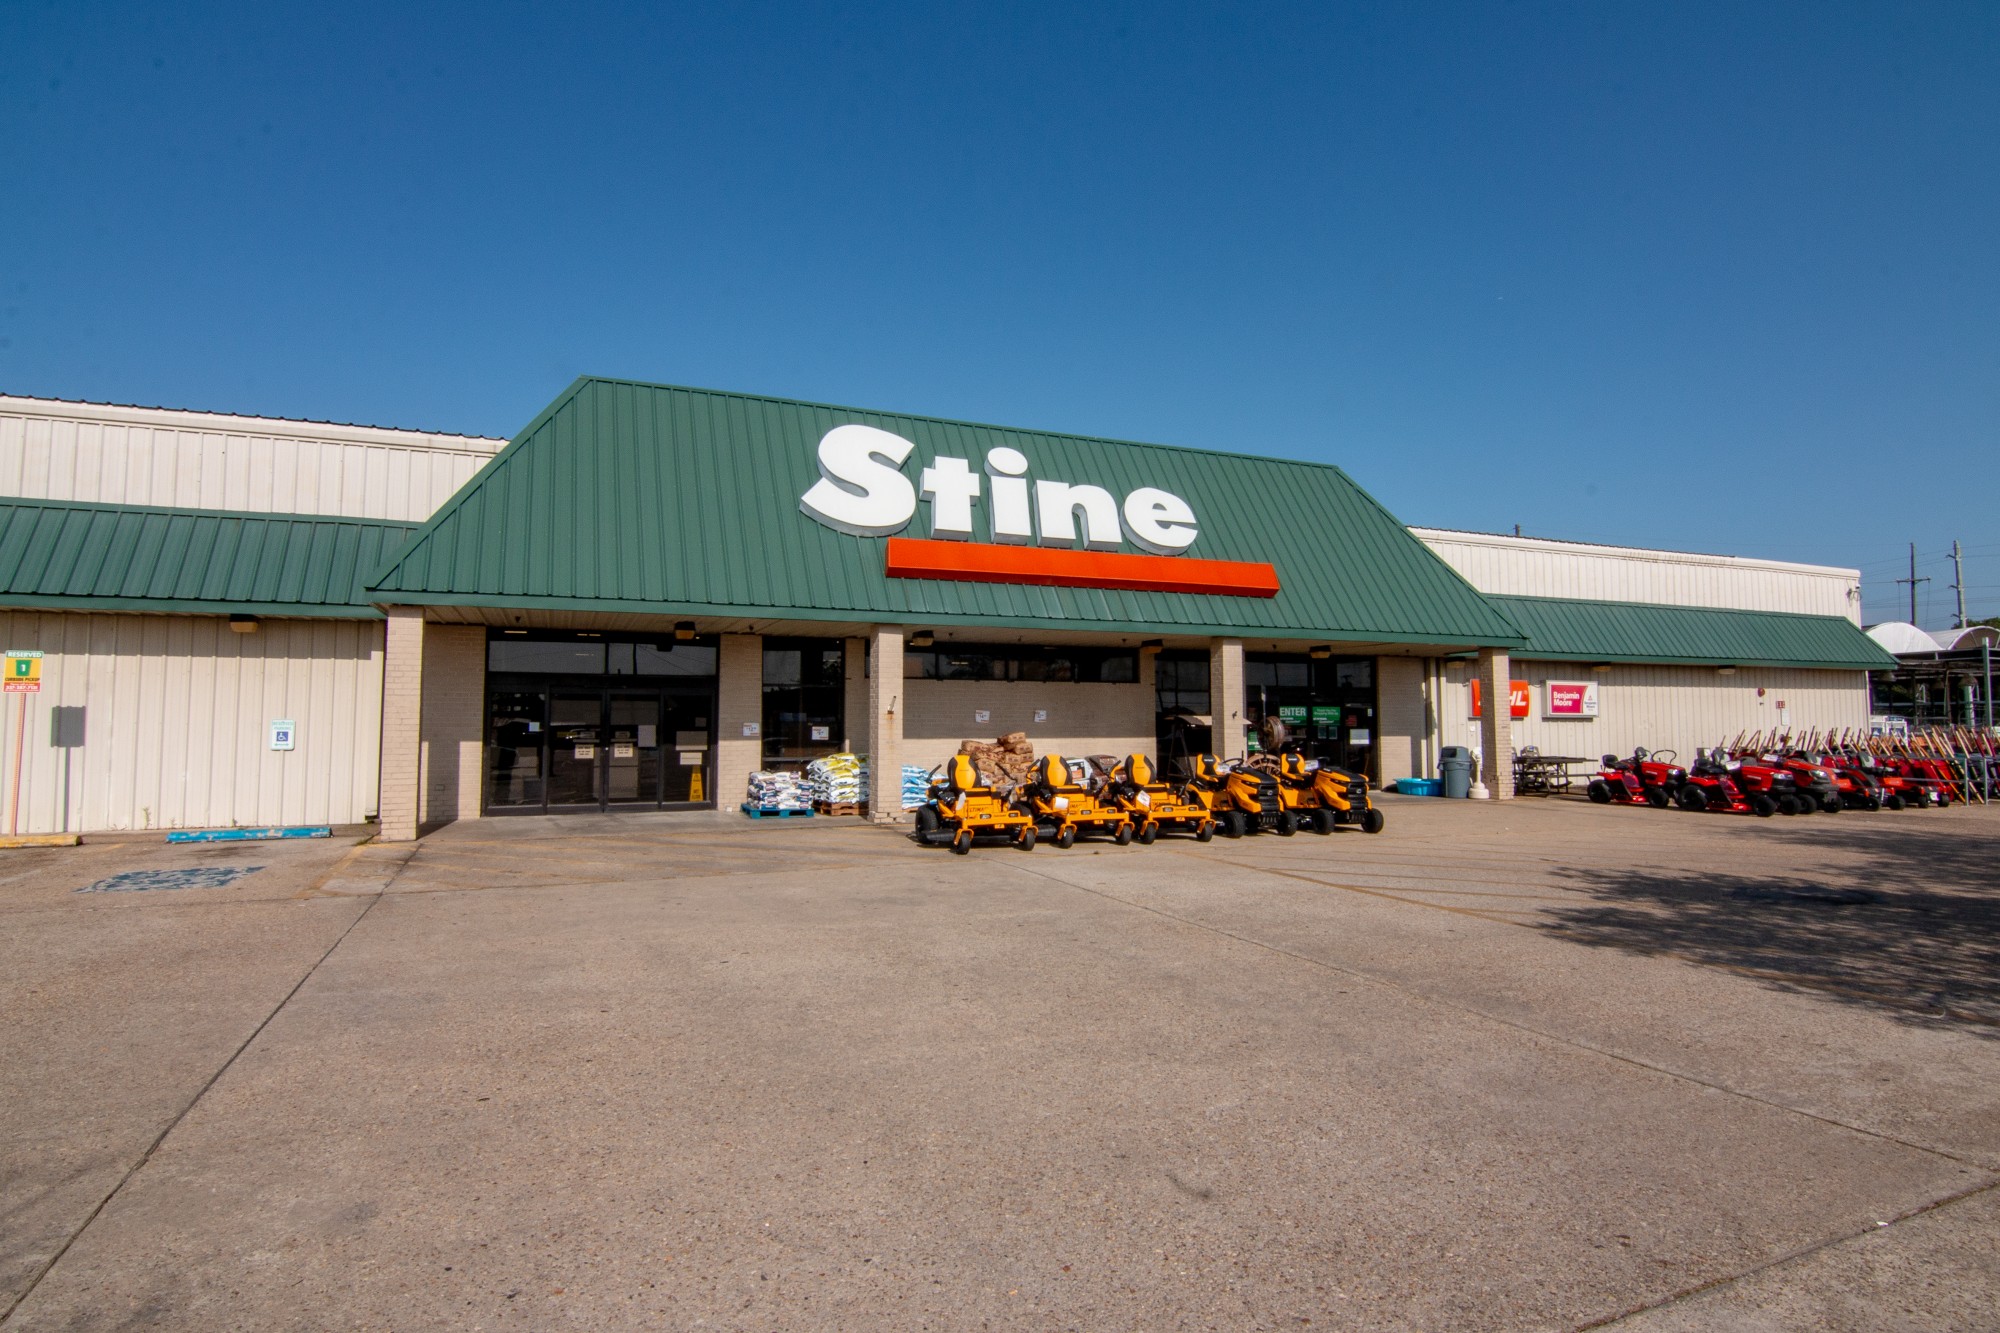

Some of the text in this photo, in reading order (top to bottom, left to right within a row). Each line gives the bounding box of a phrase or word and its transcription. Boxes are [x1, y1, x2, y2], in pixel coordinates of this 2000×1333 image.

[800, 424, 1199, 556] Stine
[20, 664, 26, 672] 1
[1553, 691, 1580, 700] Benjamin
[1553, 698, 1573, 706] Moore
[1280, 707, 1306, 716] ENTER
